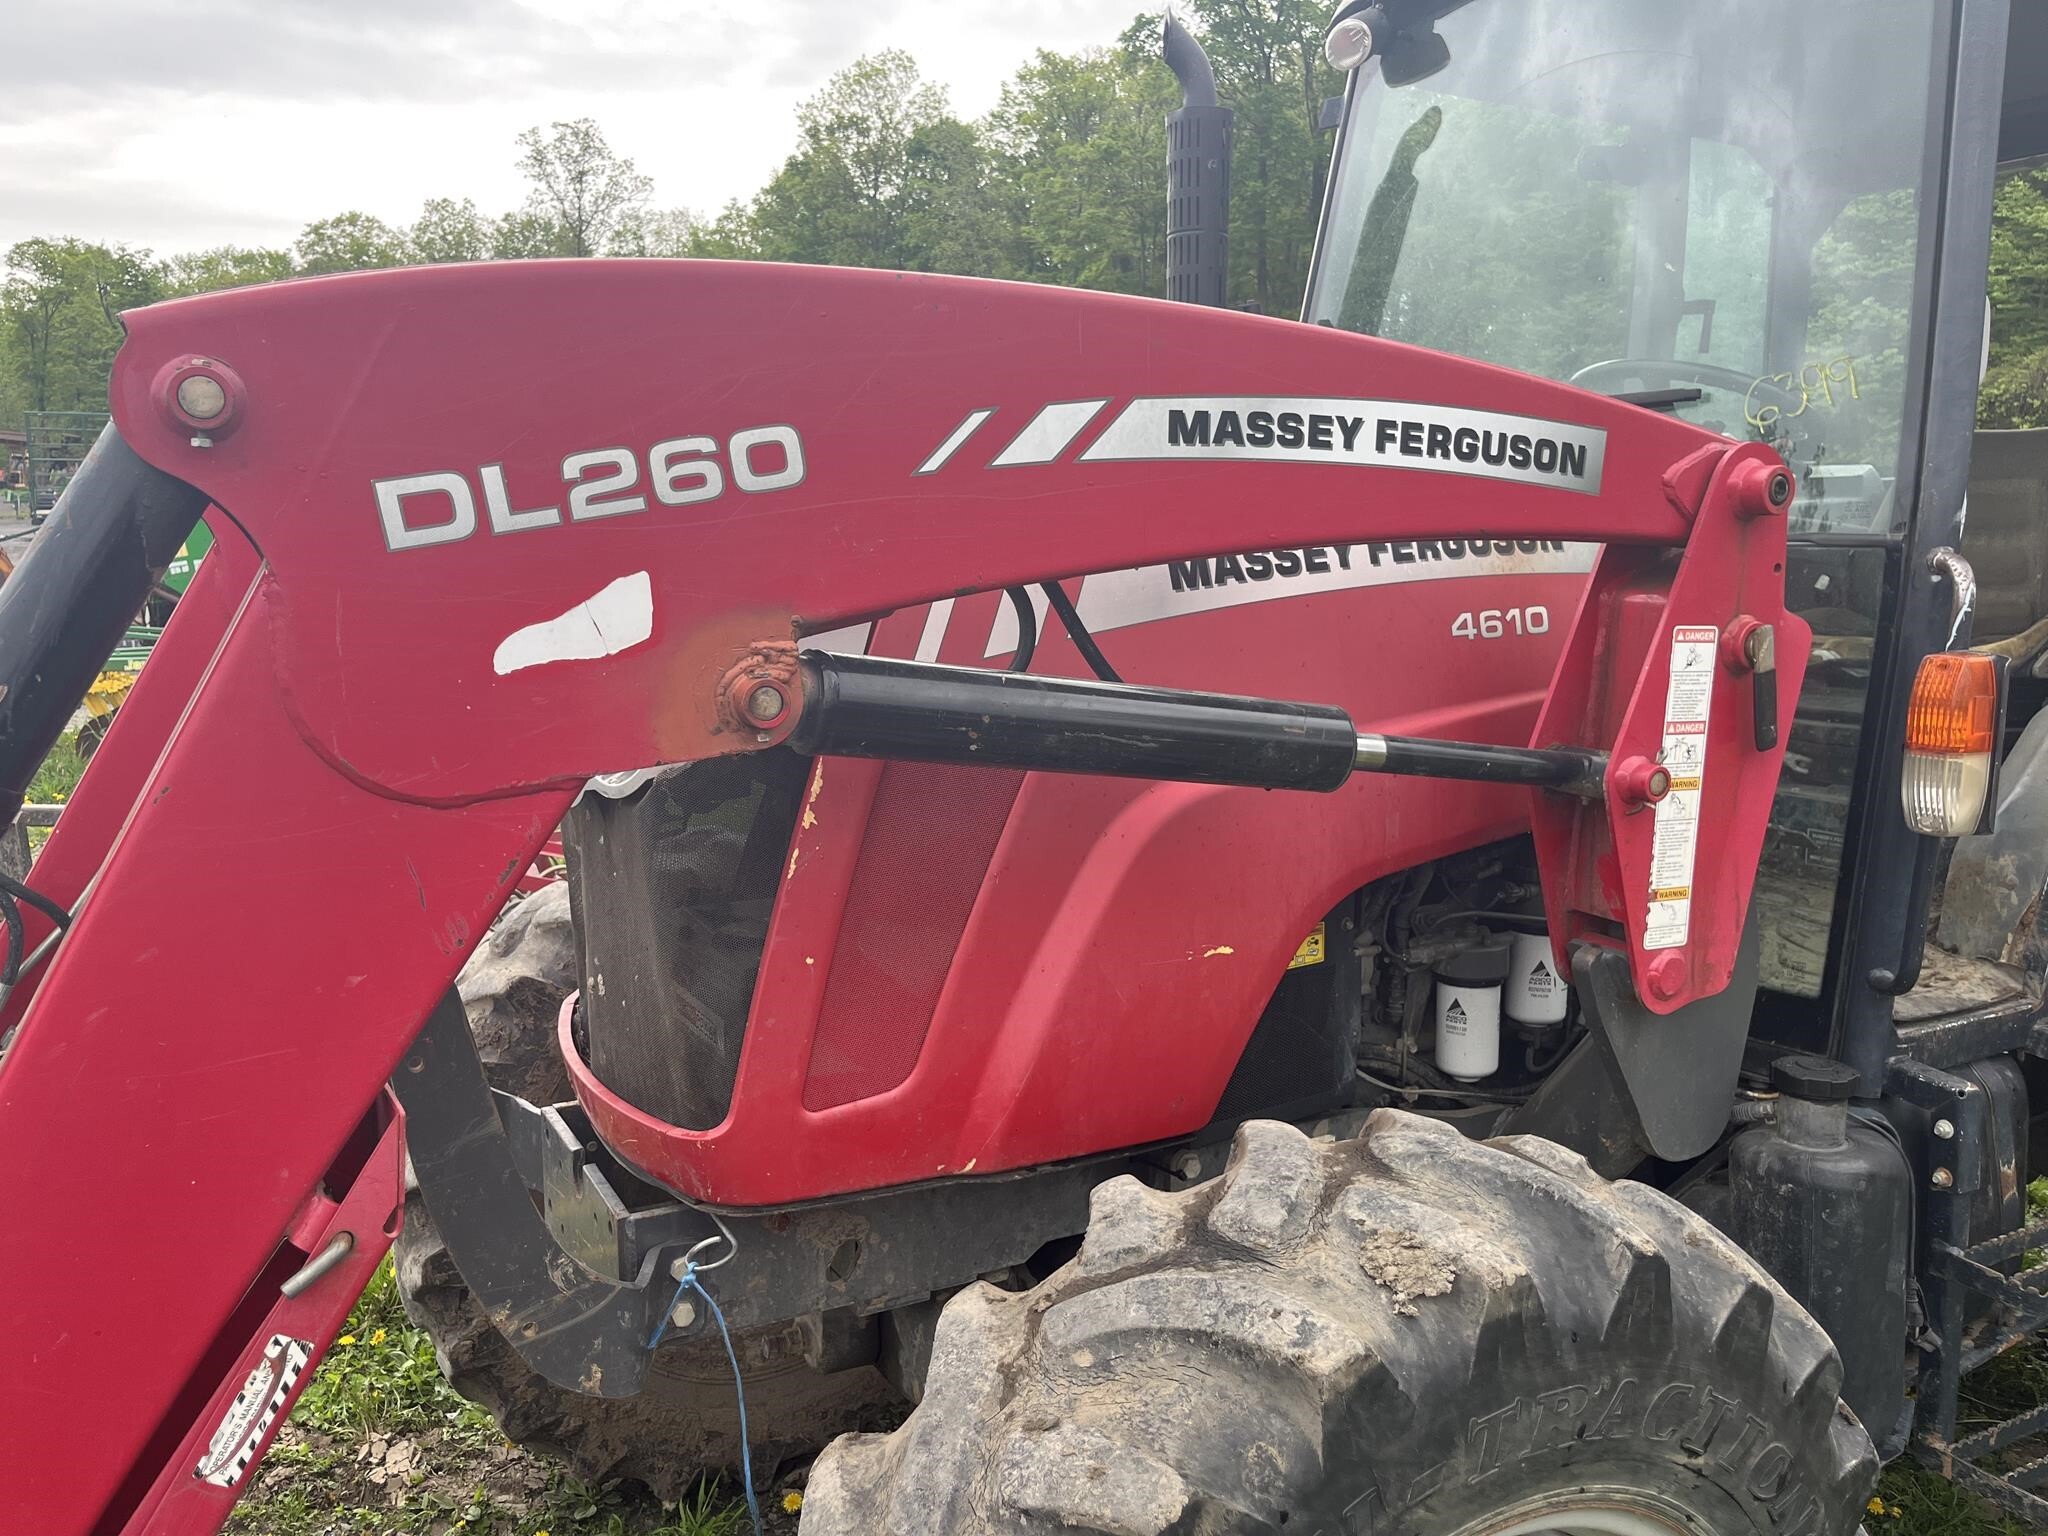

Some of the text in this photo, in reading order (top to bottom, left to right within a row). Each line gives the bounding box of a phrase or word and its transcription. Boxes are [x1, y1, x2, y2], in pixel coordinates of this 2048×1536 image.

[1168, 409, 1588, 478] MASSEY FERGUSON
[371, 423, 807, 552] DL260
[1168, 543, 1351, 592] MASSEY
[1451, 605, 1549, 640] 4610
[1685, 631, 1715, 641] DANGER
[1676, 723, 1704, 733] DANGER
[1658, 889, 1687, 899] WARNING
[239, 1386, 265, 1420] MANUAL
